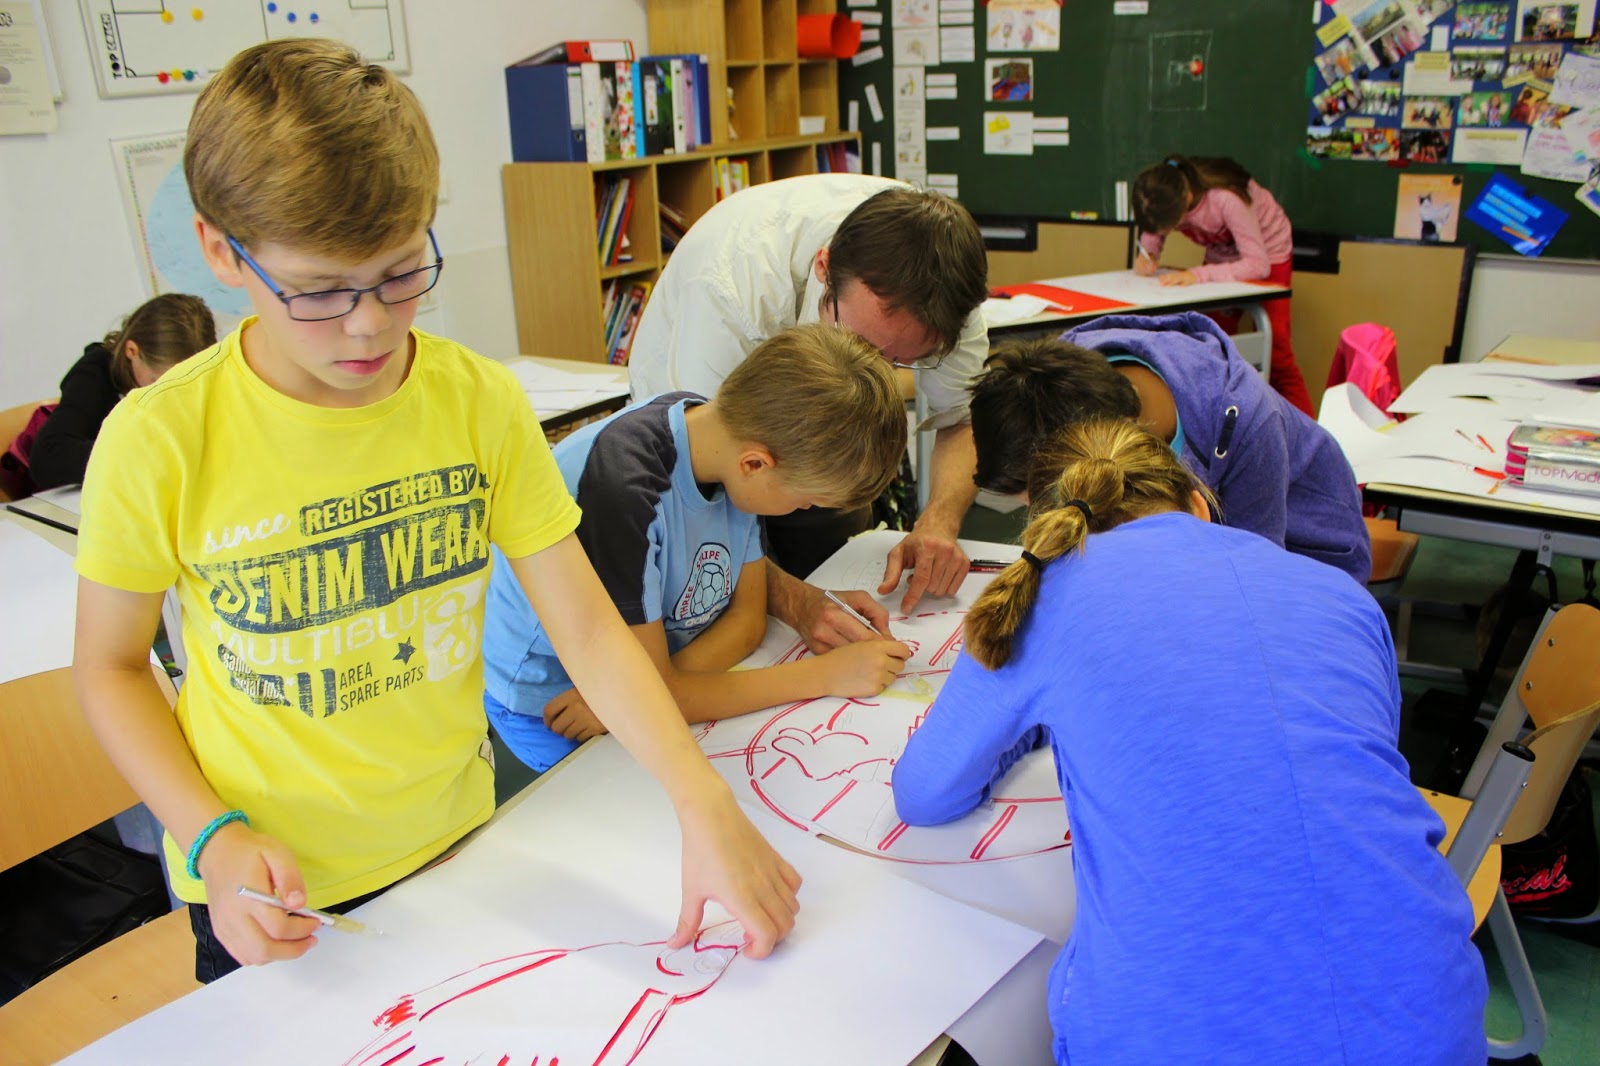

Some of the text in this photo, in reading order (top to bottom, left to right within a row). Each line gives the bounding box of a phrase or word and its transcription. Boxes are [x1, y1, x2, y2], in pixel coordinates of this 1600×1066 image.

[1533, 464, 1600, 485] TOPMod
[305, 468, 475, 534] REGISTERED BY
[204, 513, 292, 555] since
[340, 662, 373, 690] AREA
[340, 665, 425, 711] SPARE PARTS
